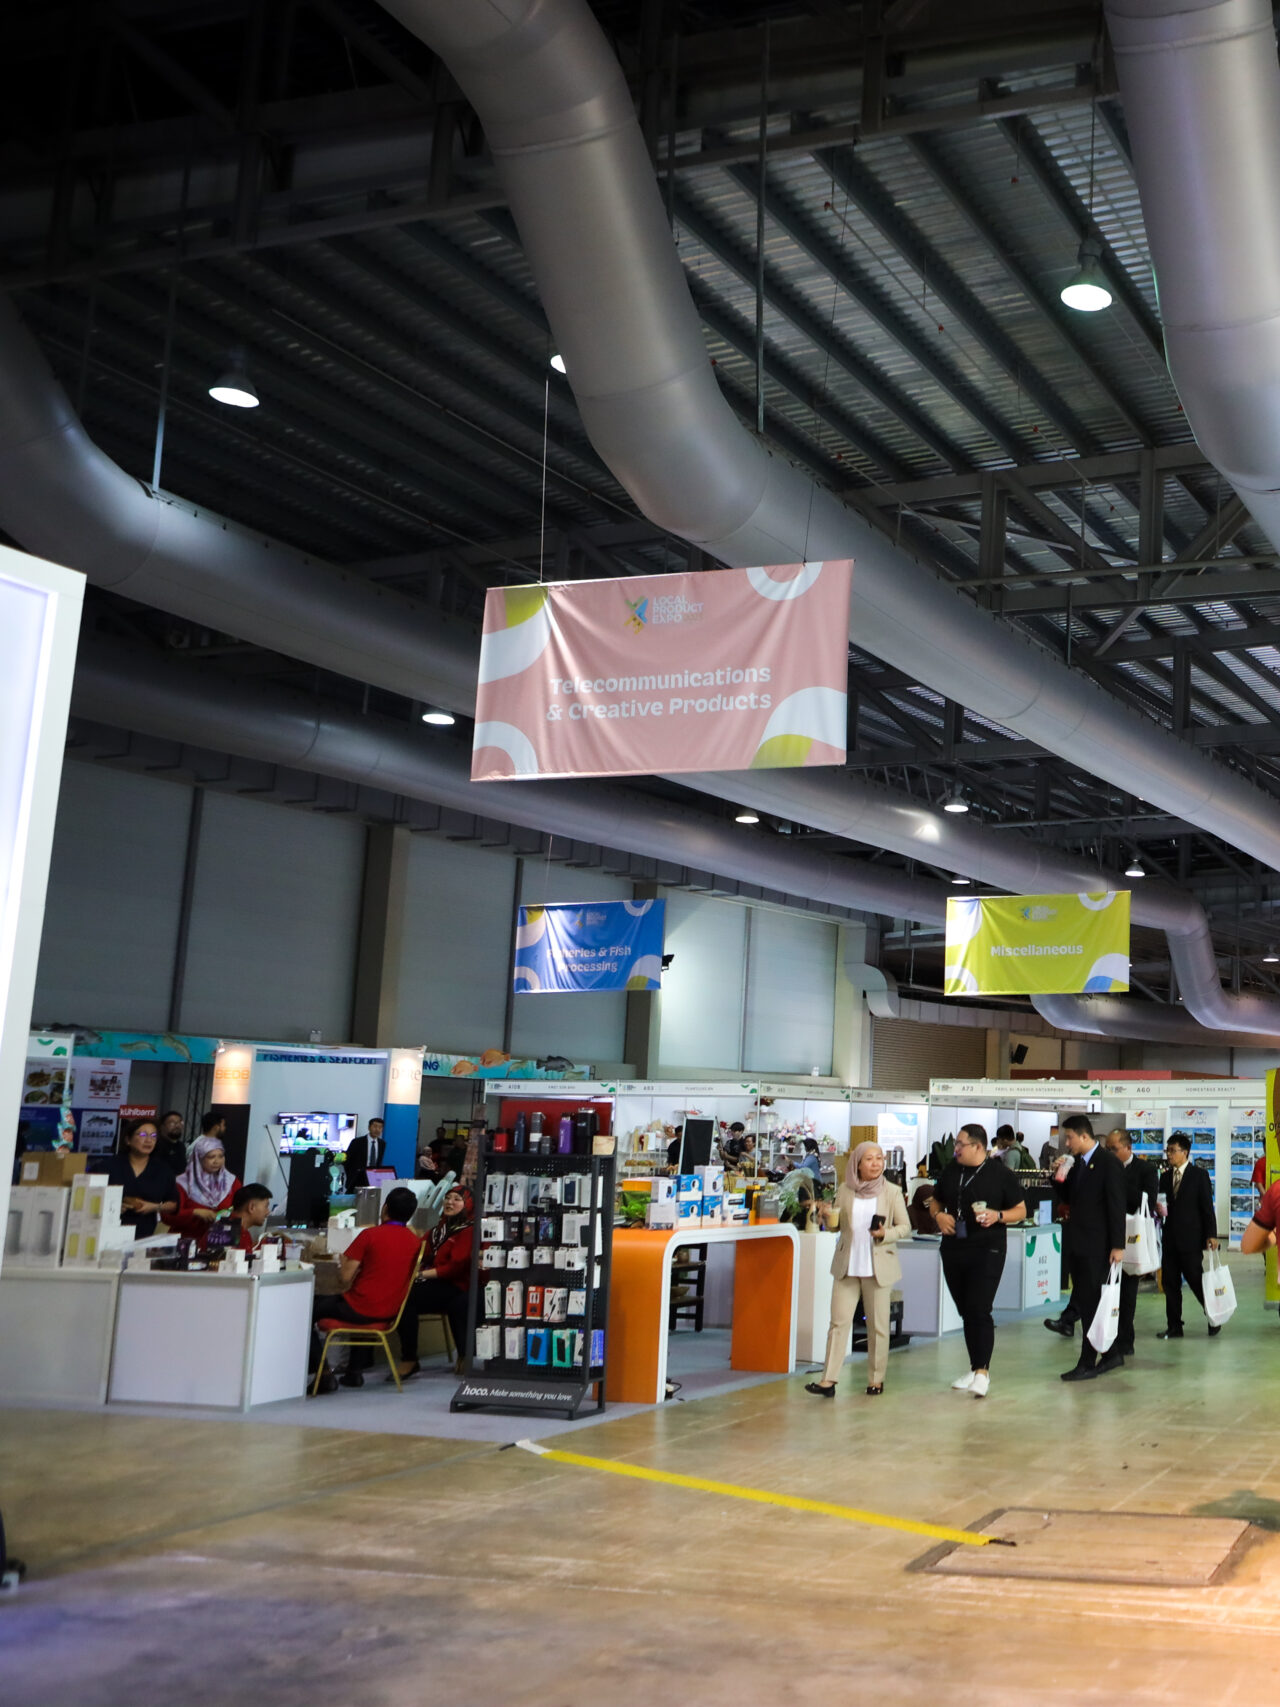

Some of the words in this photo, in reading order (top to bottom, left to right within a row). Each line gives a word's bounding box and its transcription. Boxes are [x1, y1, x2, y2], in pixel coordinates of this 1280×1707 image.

[653, 595, 688, 605] LOCAL
[653, 602, 704, 614] PRODUCT
[652, 613, 683, 624] EXPO
[549, 666, 771, 695] Telecommunications
[546, 706, 563, 721] &
[568, 698, 663, 720] Creative
[669, 691, 772, 715] Products
[598, 947, 609, 957] &
[610, 945, 632, 956] Fish
[990, 944, 1084, 957] Miscellaneous
[462, 1386, 489, 1396] hoco.
[490, 1389, 508, 1397] Make
[509, 1390, 542, 1400] something
